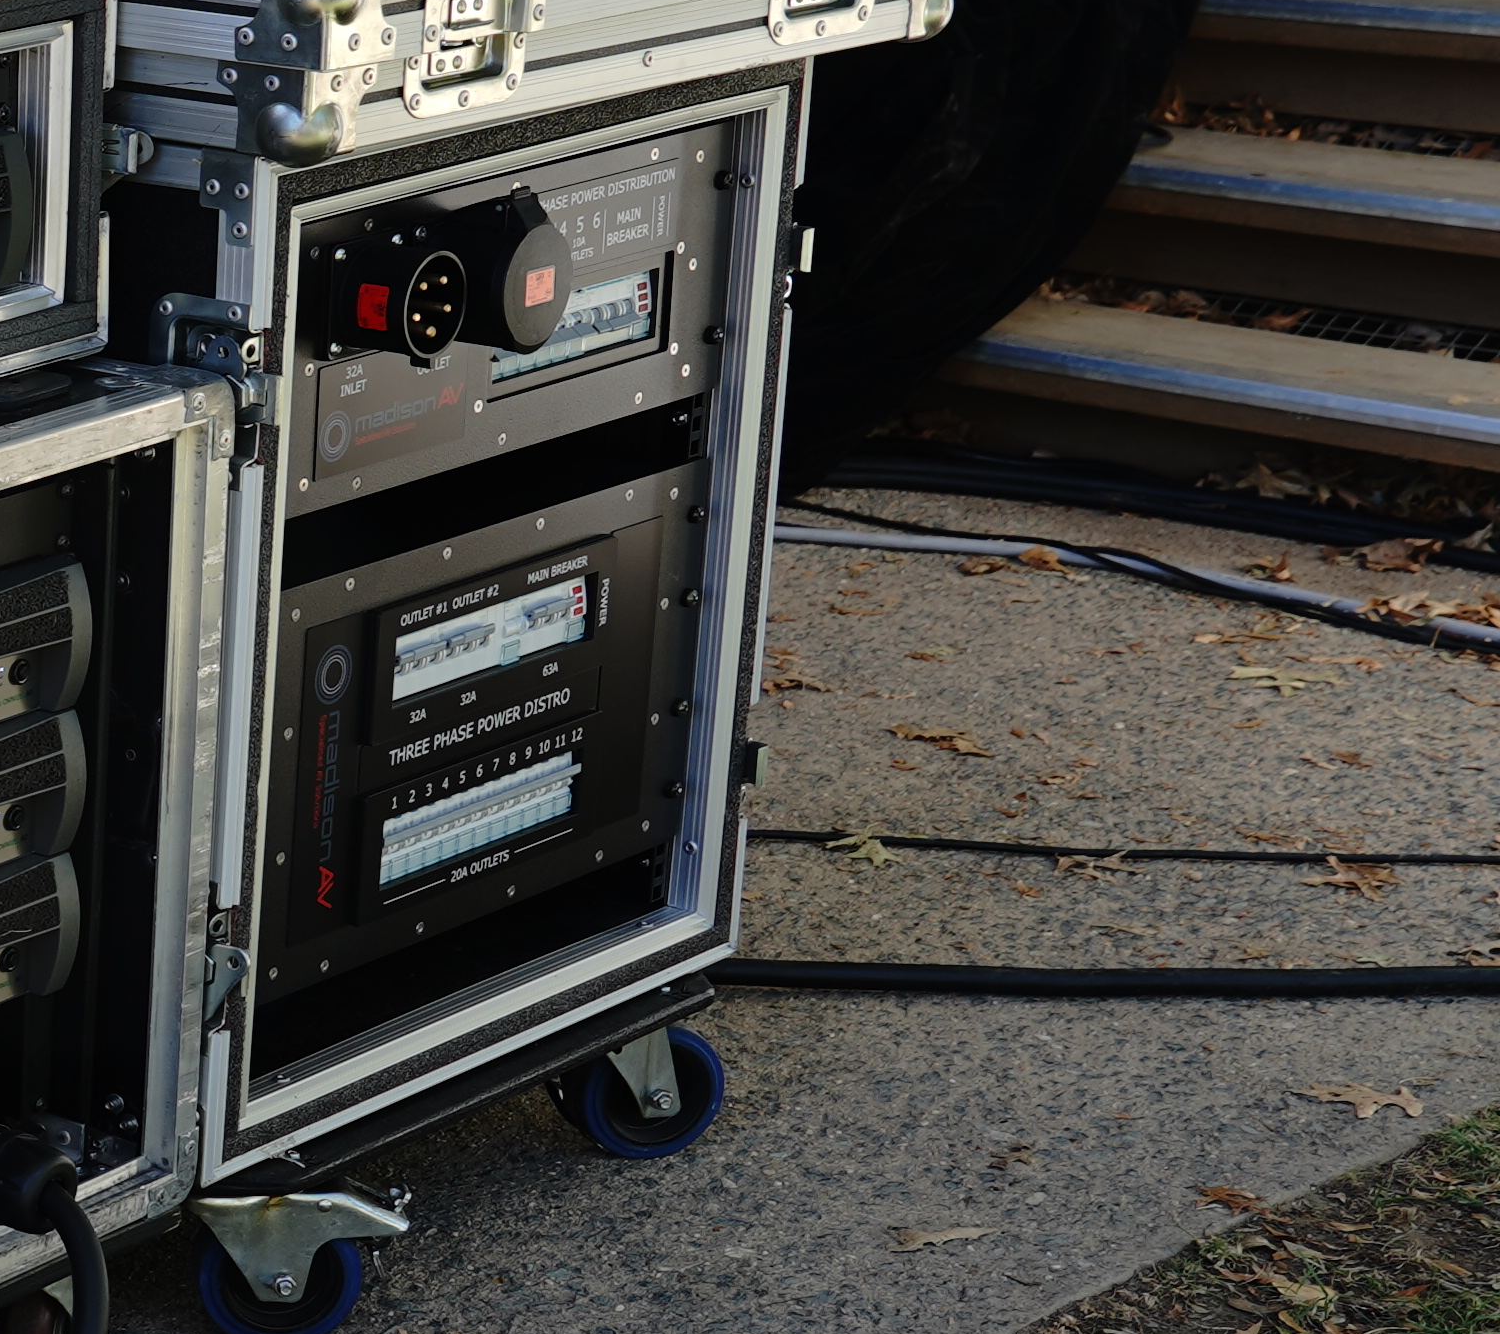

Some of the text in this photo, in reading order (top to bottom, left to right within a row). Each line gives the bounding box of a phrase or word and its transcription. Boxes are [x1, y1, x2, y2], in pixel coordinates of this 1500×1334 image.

[571, 186, 606, 206] POWER
[608, 167, 676, 198] DISTRIBUTION
[560, 212, 601, 236] 4 5 6
[617, 207, 641, 225] MAIN
[657, 195, 666, 237] POWER
[573, 237, 586, 248] 10A
[607, 224, 650, 246] BREAKER
[346, 363, 363, 379] 32A
[340, 379, 368, 397] INLET
[355, 382, 464, 434] madisonAV
[527, 555, 589, 585] MAIN BREAKER
[400, 584, 500, 627] OUTLET #1 OUTLET #2
[599, 578, 610, 627] POWER
[542, 662, 559, 677] 63A
[460, 690, 476, 706] 32A
[388, 688, 571, 767] THREE PHASE POWER DISTRO
[409, 708, 426, 725] 32A
[391, 727, 584, 809] 1 2 3 4 5 6 7 8 9 10 11 12
[317, 710, 341, 909] madisonAV
[450, 849, 510, 883] 20A OUTLETS
